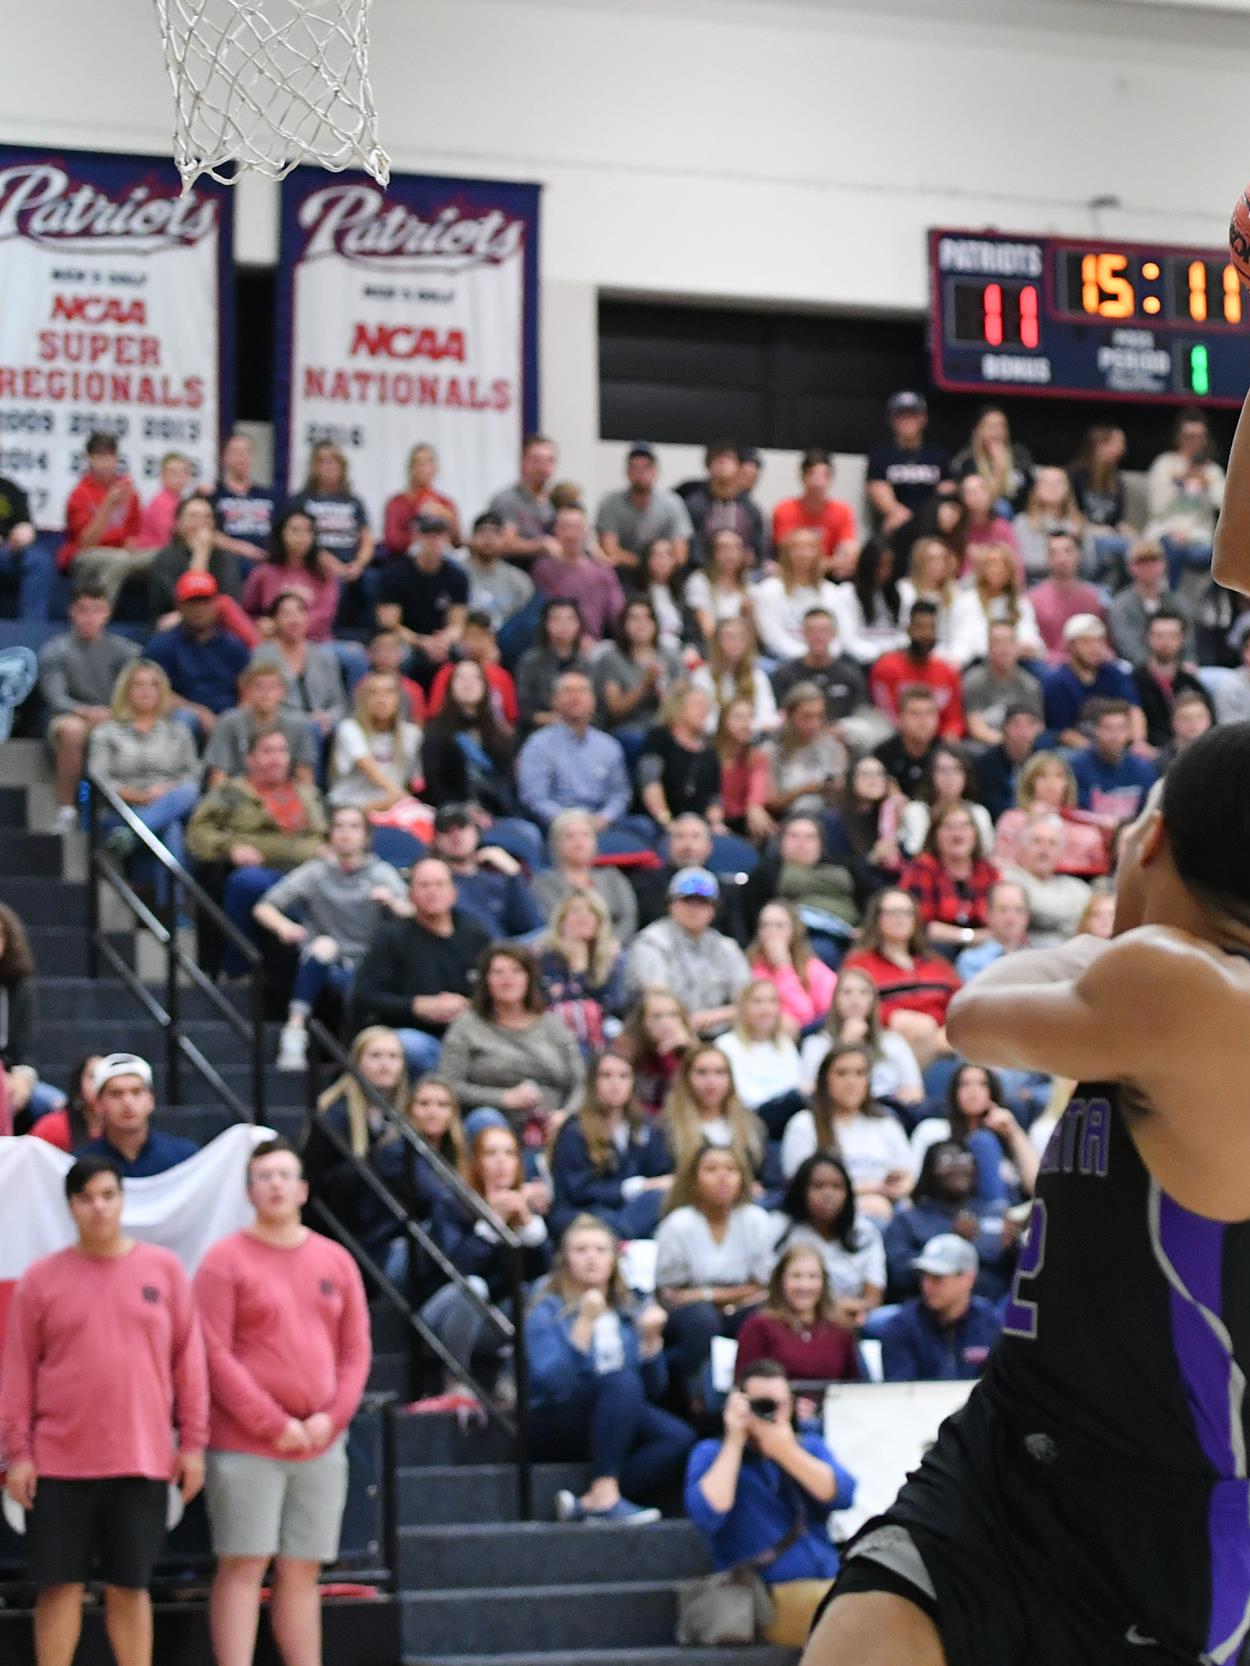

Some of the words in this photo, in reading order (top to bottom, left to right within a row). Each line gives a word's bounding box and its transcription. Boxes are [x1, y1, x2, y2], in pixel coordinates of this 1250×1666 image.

[0, 164, 219, 247] Patriots
[299, 184, 523, 262] Patriots
[939, 238, 1042, 277] PATRIOTS
[1081, 253, 1242, 324] 15:11
[52, 294, 147, 326] NCAA
[983, 283, 1039, 349] 11
[38, 330, 161, 366] SUPER
[351, 323, 466, 363] NCAA
[0, 368, 204, 409] REGIONALS
[304, 367, 511, 411] NATIONALS
[981, 353, 1051, 384] BONUS
[1190, 343, 1209, 396] 1
